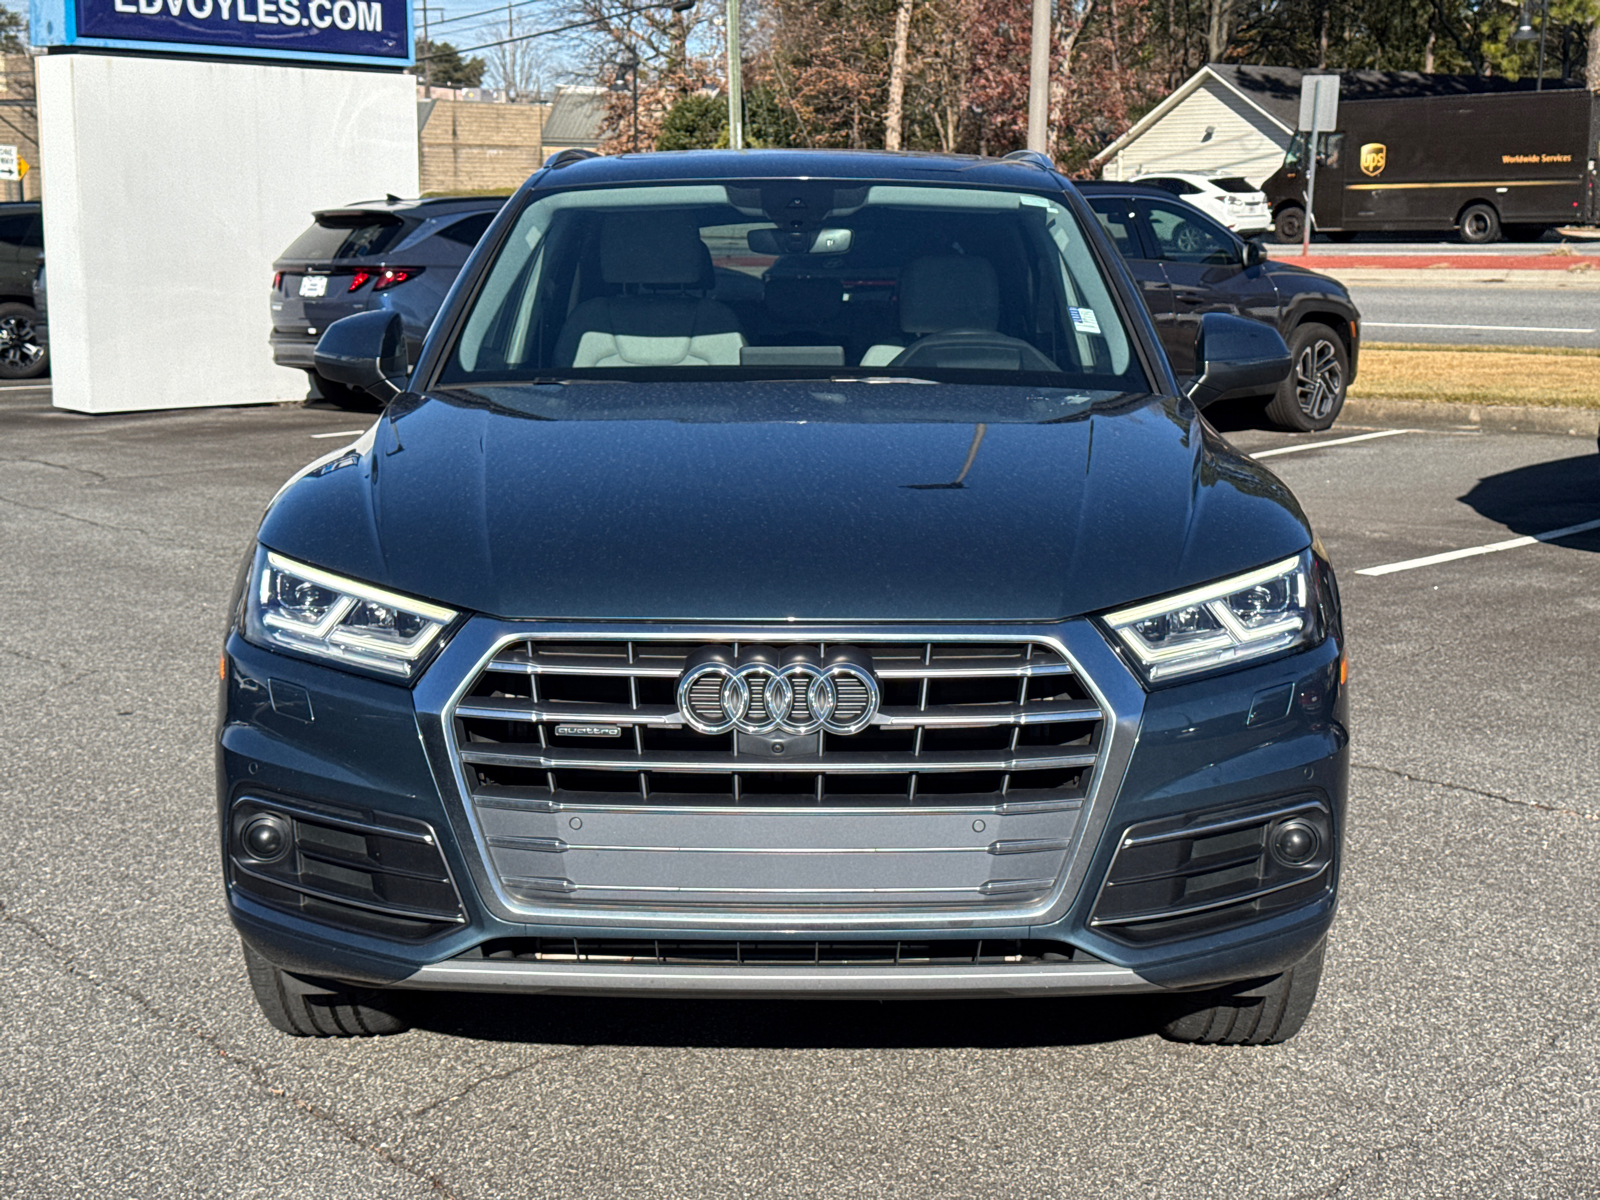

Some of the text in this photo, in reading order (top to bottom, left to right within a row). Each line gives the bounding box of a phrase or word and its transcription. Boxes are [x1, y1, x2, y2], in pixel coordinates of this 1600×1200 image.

[1363, 153, 1385, 172] ups
[1502, 153, 1572, 164] Worldwide Services
[558, 727, 618, 735] quattro
